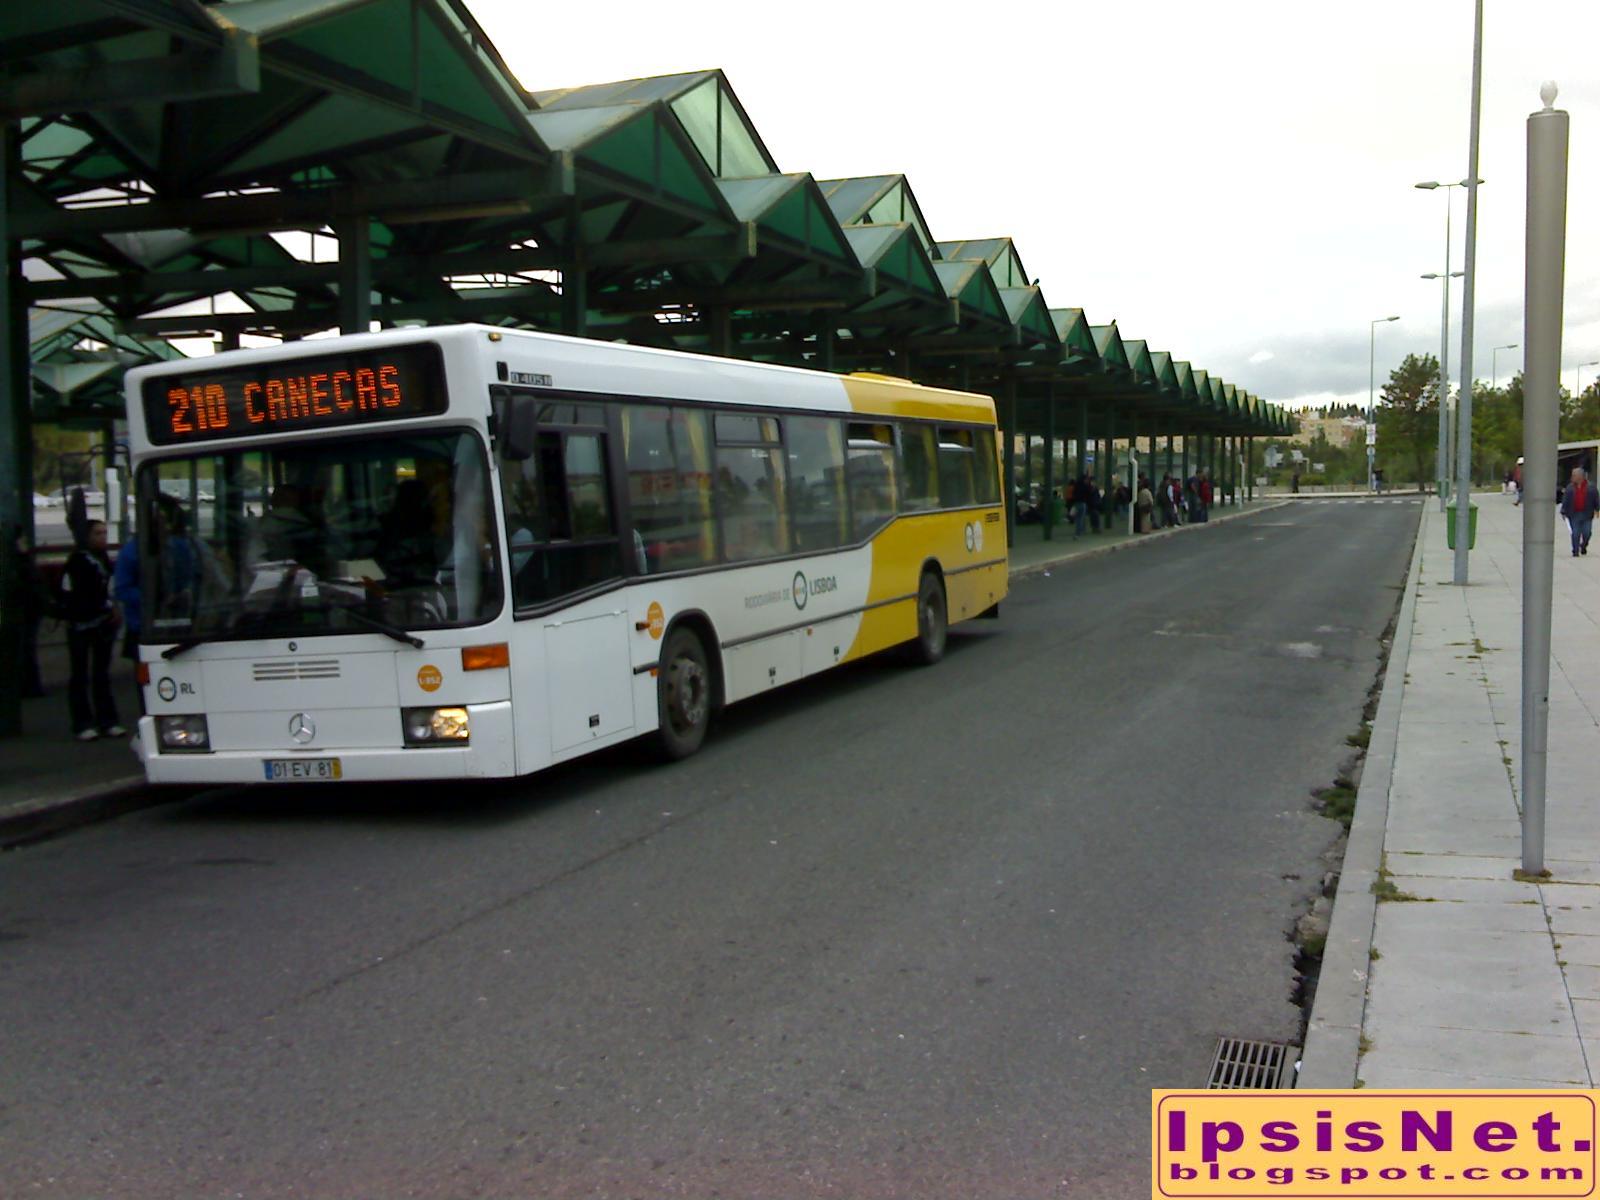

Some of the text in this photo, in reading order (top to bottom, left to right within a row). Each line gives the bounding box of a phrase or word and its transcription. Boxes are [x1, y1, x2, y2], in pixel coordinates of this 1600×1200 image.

[167, 383, 230, 433] 210
[809, 576, 837, 596] LISBOA
[180, 682, 196, 695] RL
[274, 761, 332, 777] 01 EV 81
